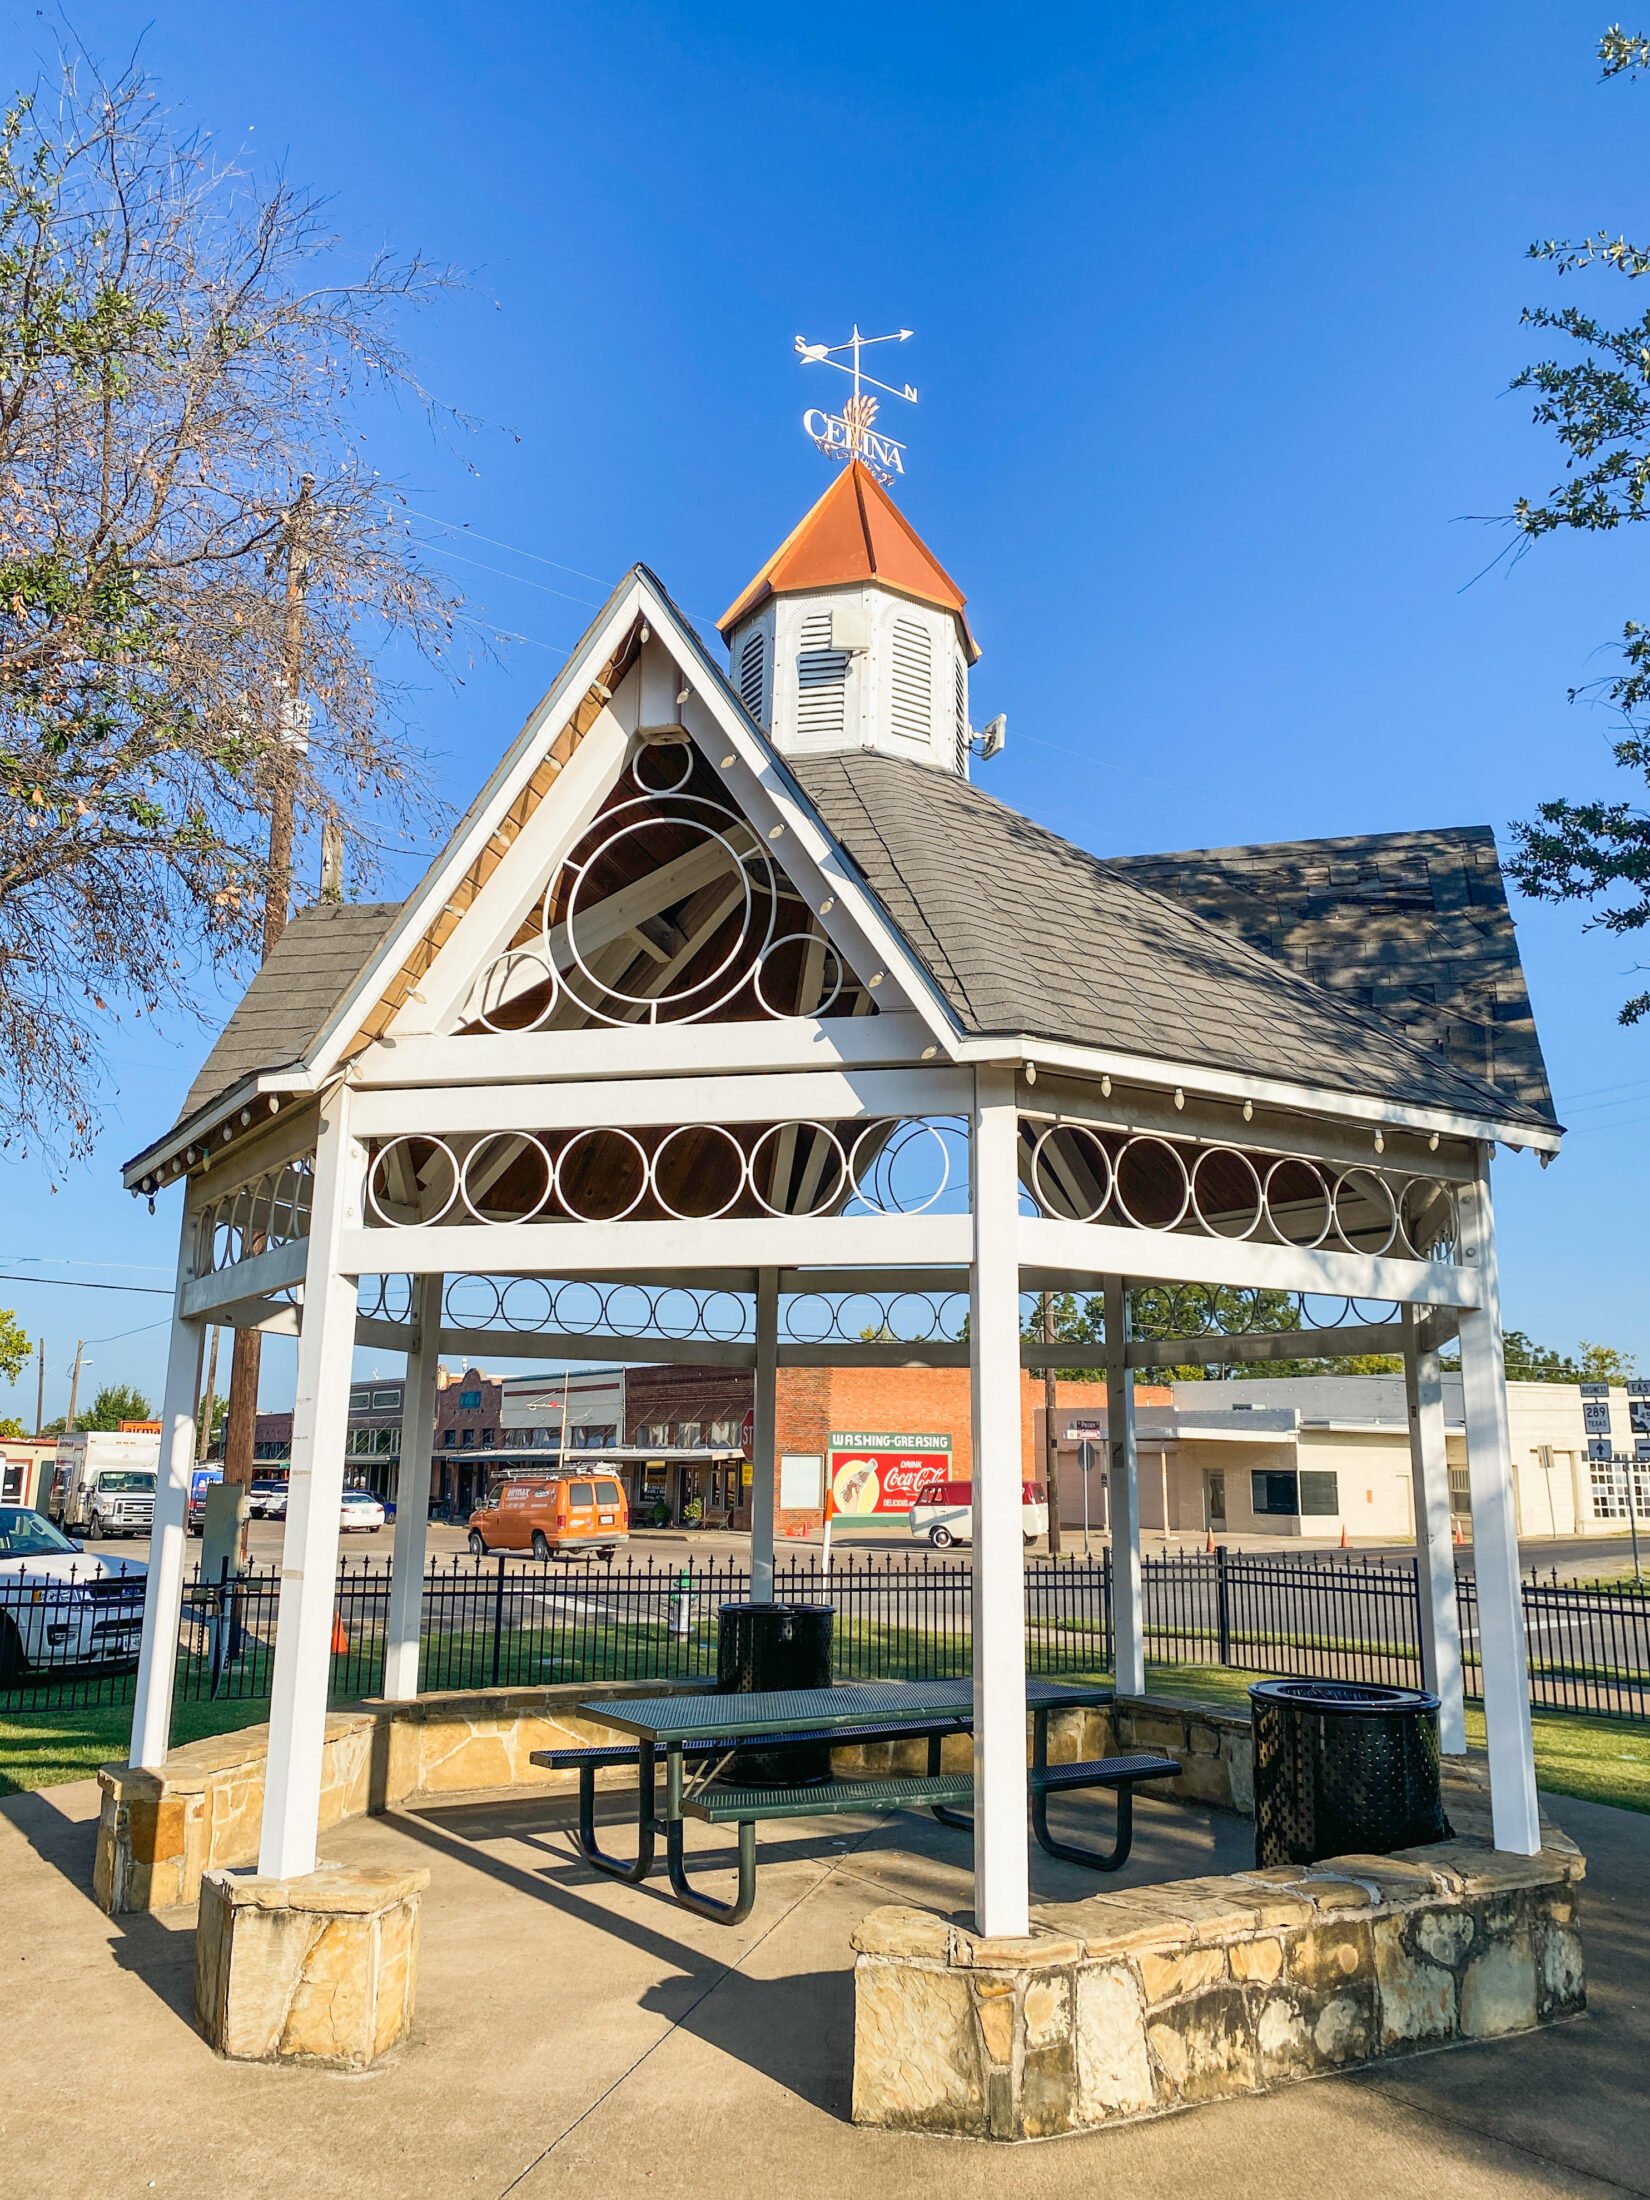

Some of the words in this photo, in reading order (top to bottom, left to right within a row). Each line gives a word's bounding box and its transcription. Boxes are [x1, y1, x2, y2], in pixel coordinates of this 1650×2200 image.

[795, 335, 807, 351] S
[905, 383, 918, 404] N
[803, 408, 905, 474] CELINA
[1586, 1407, 1606, 1418] 289
[126, 1425, 161, 1434] airma
[743, 1426, 754, 1445] ST
[833, 1434, 948, 1447] WASHING-GREASING
